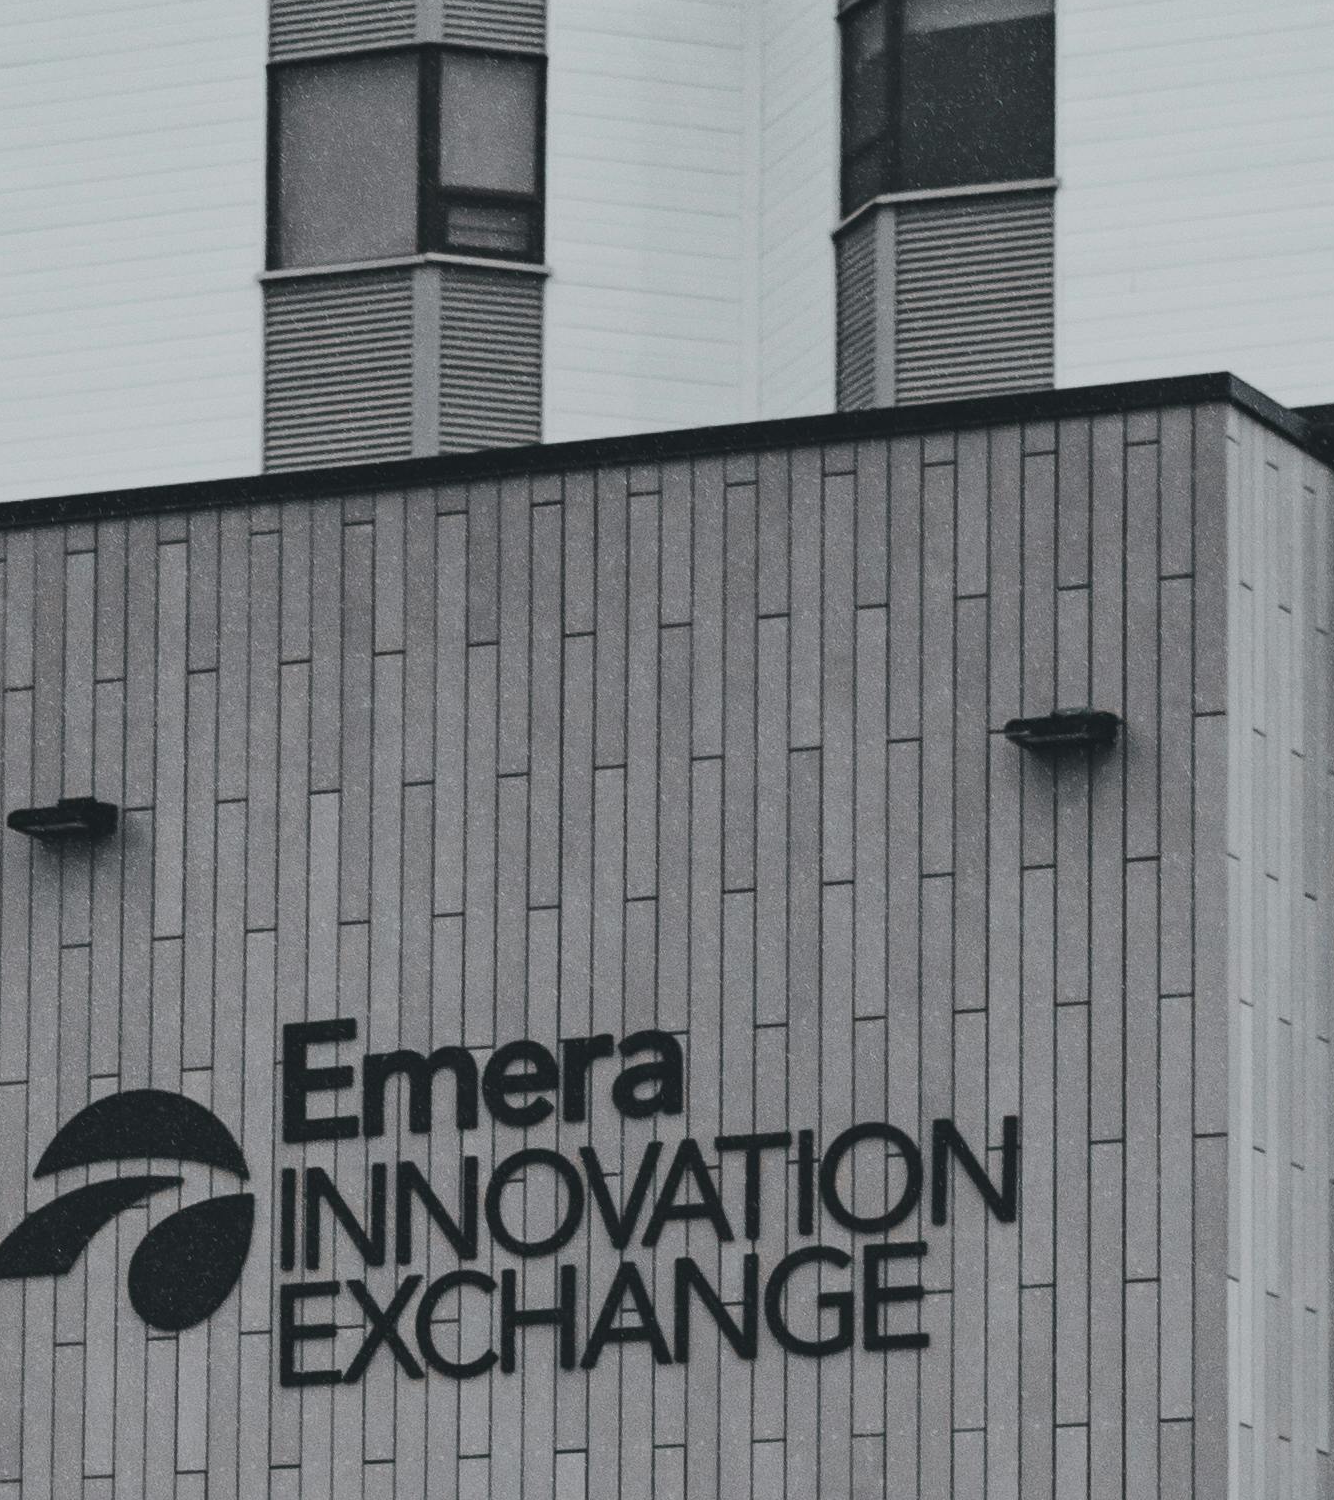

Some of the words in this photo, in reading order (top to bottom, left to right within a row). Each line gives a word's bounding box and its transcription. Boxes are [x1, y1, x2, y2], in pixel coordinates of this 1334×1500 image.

[281, 1018, 684, 1144] Emera
[279, 1115, 1020, 1272] INNOVATION
[278, 1239, 931, 1389] EXCHANGE
